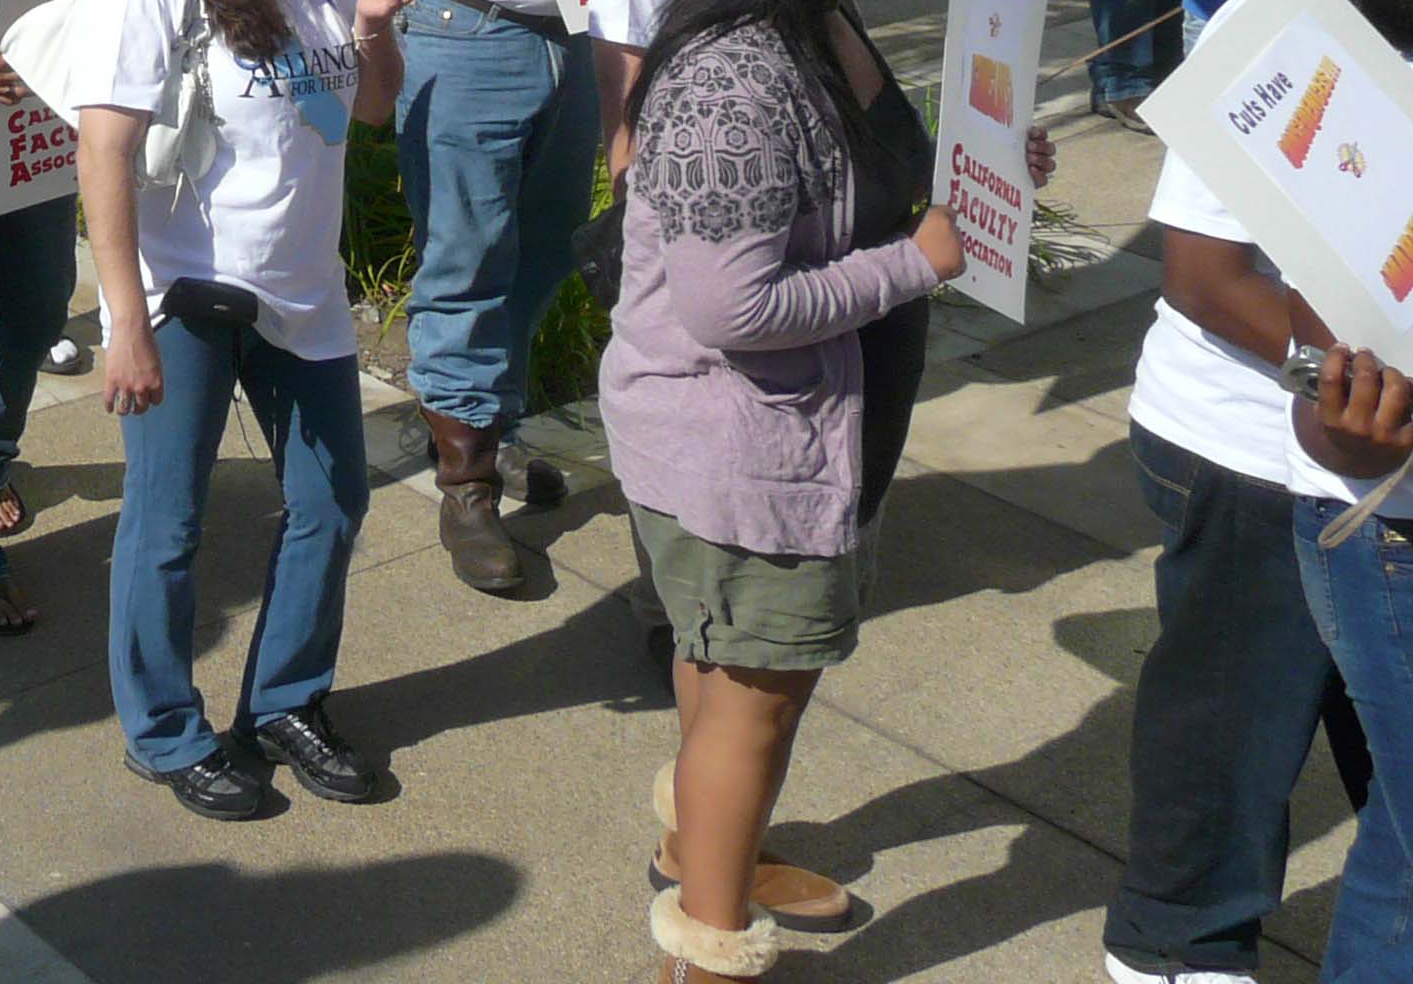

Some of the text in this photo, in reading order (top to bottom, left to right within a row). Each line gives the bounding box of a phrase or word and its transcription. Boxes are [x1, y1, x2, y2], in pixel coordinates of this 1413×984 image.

[237, 41, 359, 98] ALLIANC
[291, 79, 317, 97] FOR
[320, 76, 345, 92] THE
[1228, 71, 1294, 135] Cuts Have
[10, 124, 78, 161] FACU
[952, 142, 1022, 212] CALIFORNIA
[947, 177, 1018, 245] FACULTY
